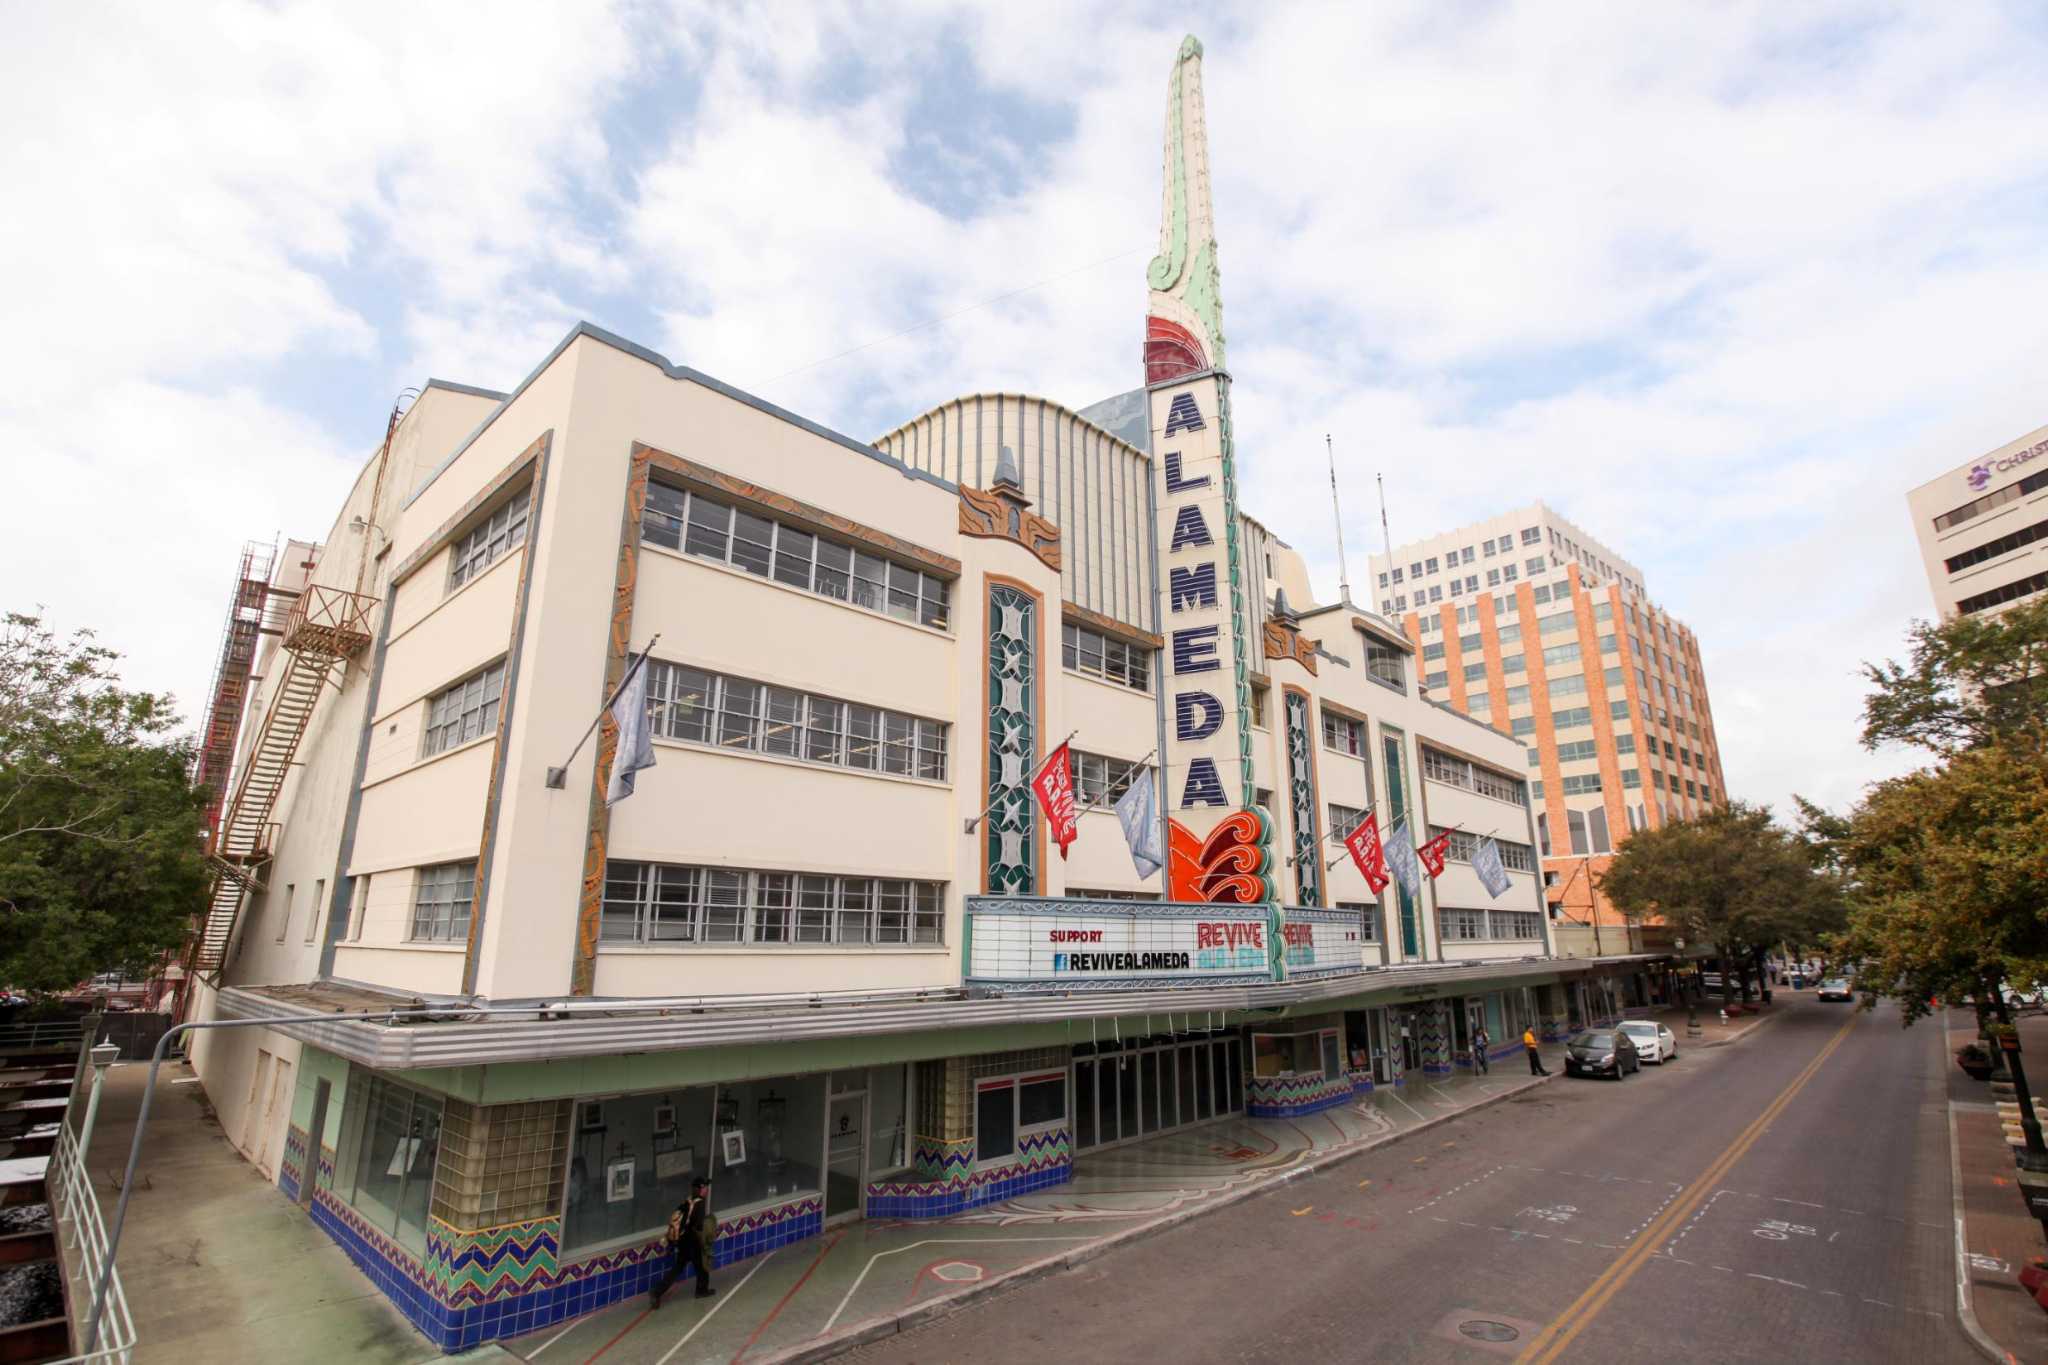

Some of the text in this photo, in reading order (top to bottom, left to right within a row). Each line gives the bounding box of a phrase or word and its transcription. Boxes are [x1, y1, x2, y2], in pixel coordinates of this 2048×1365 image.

[1164, 391, 1229, 810] ALAMEDA
[1049, 930, 1103, 943] SUPPORT
[1198, 922, 1263, 952] REVIVE
[1070, 952, 1190, 971] REVIVEALAMEDA
